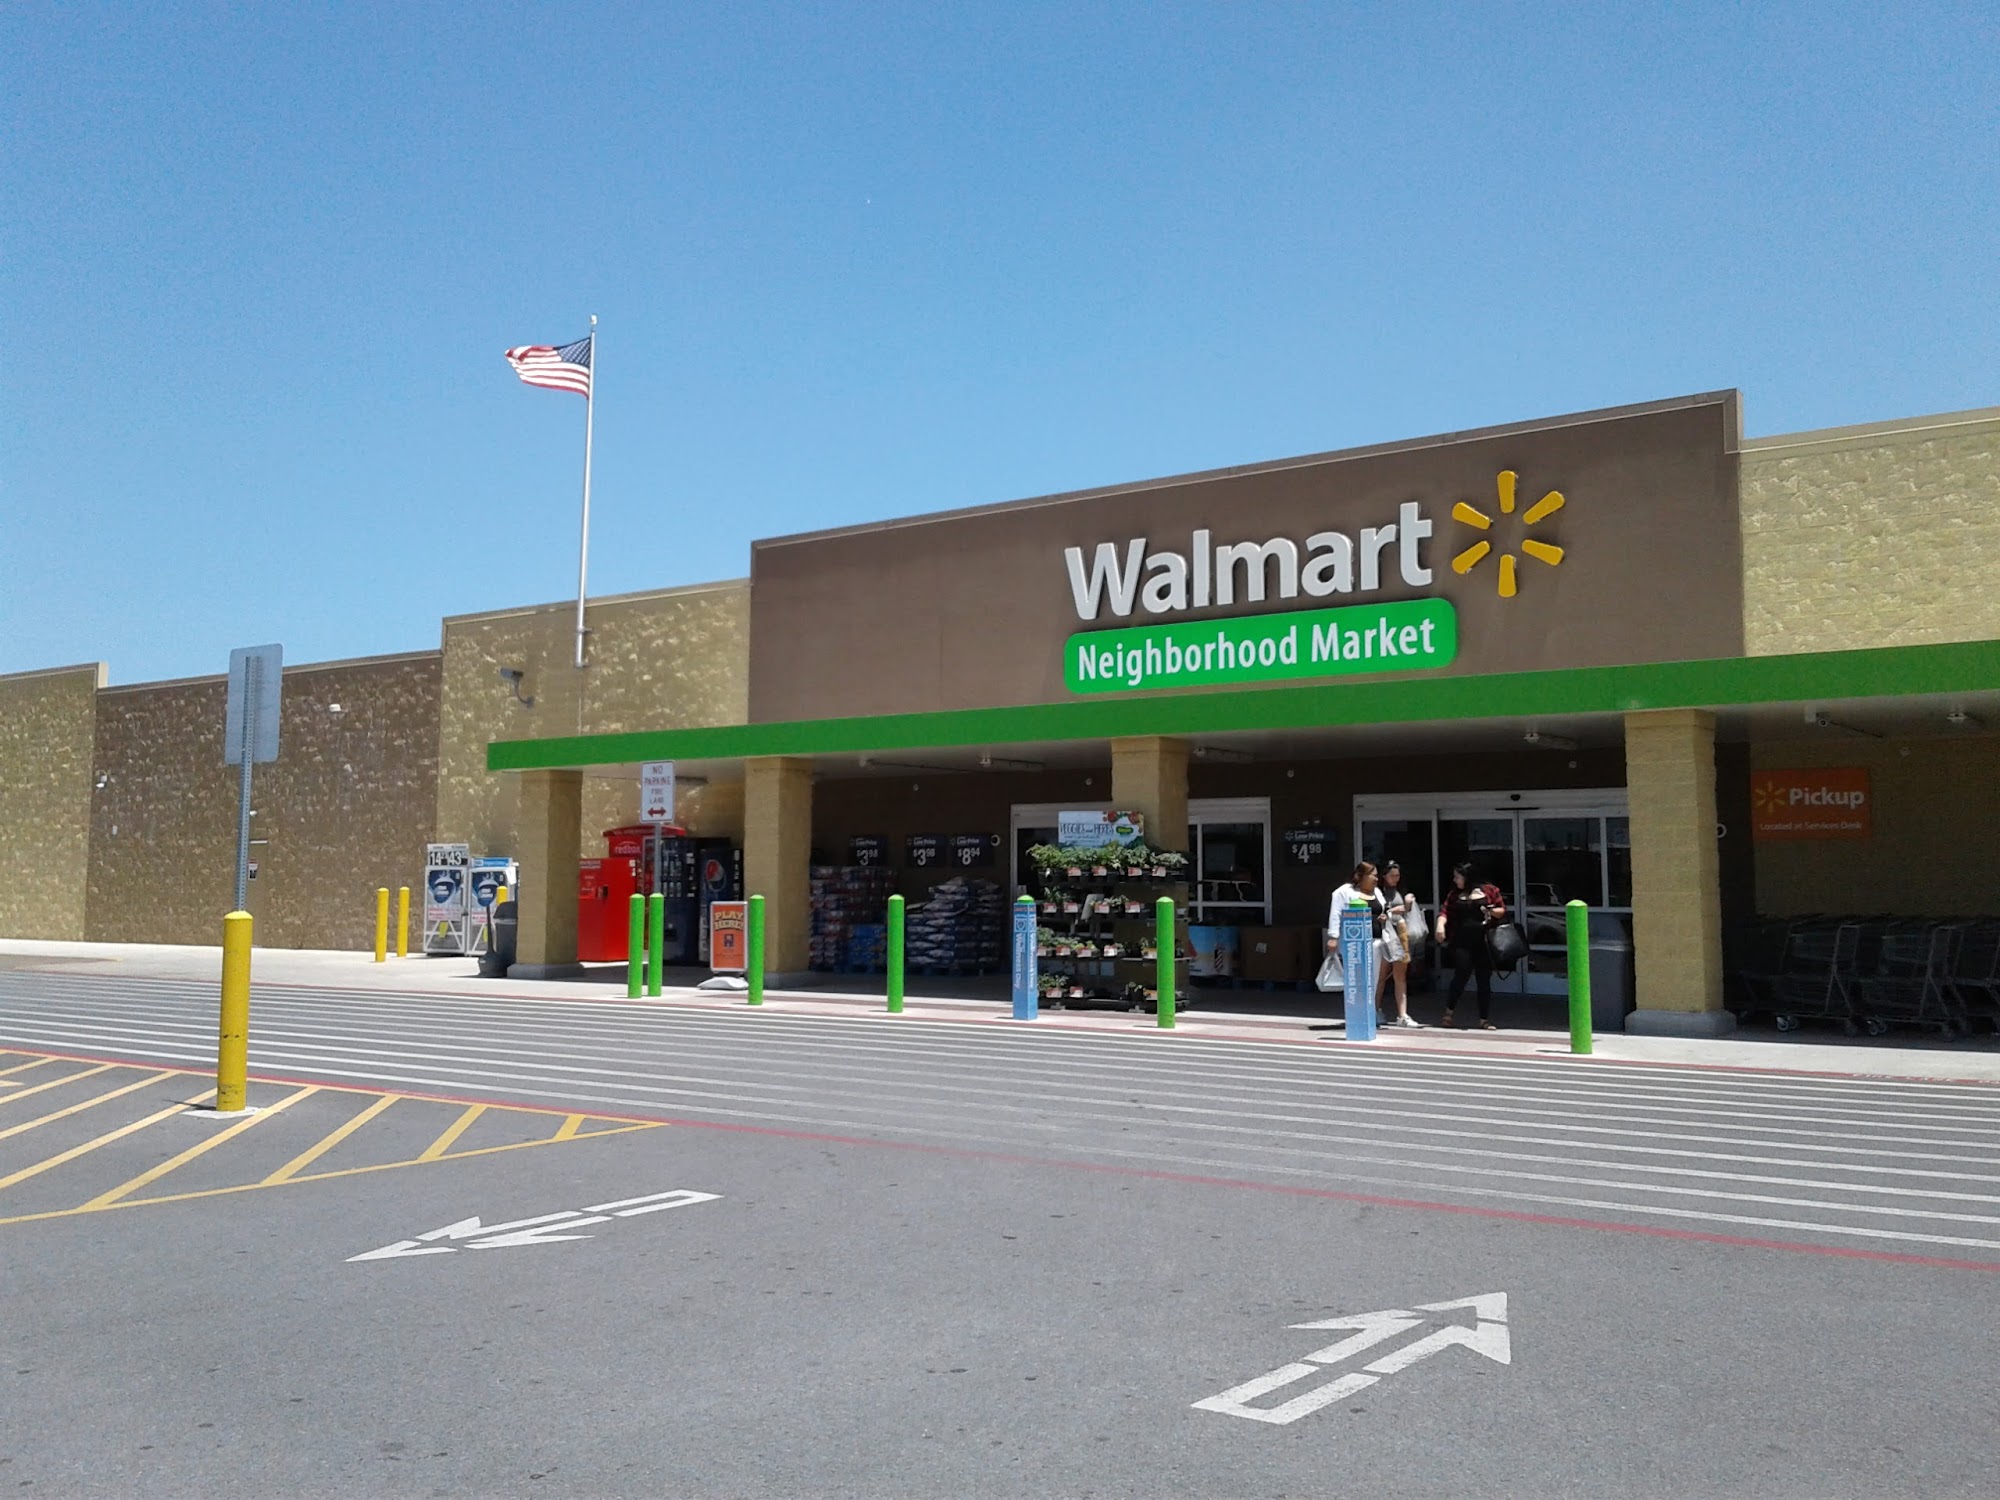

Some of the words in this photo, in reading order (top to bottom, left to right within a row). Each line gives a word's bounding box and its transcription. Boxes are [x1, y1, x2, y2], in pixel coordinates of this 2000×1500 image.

[1064, 501, 1433, 620] Walmart
[1078, 625, 1298, 686] Neighborhood
[1311, 617, 1436, 663] Market
[644, 776, 672, 785] PARKING
[652, 765, 664, 775] NO
[1789, 786, 1865, 810] Pickup
[614, 844, 642, 854] redbox
[714, 910, 744, 921] PLAY
[1015, 932, 1023, 972] Wellness
[1346, 941, 1358, 986] Wellness
[1346, 987, 1357, 1005] Day
